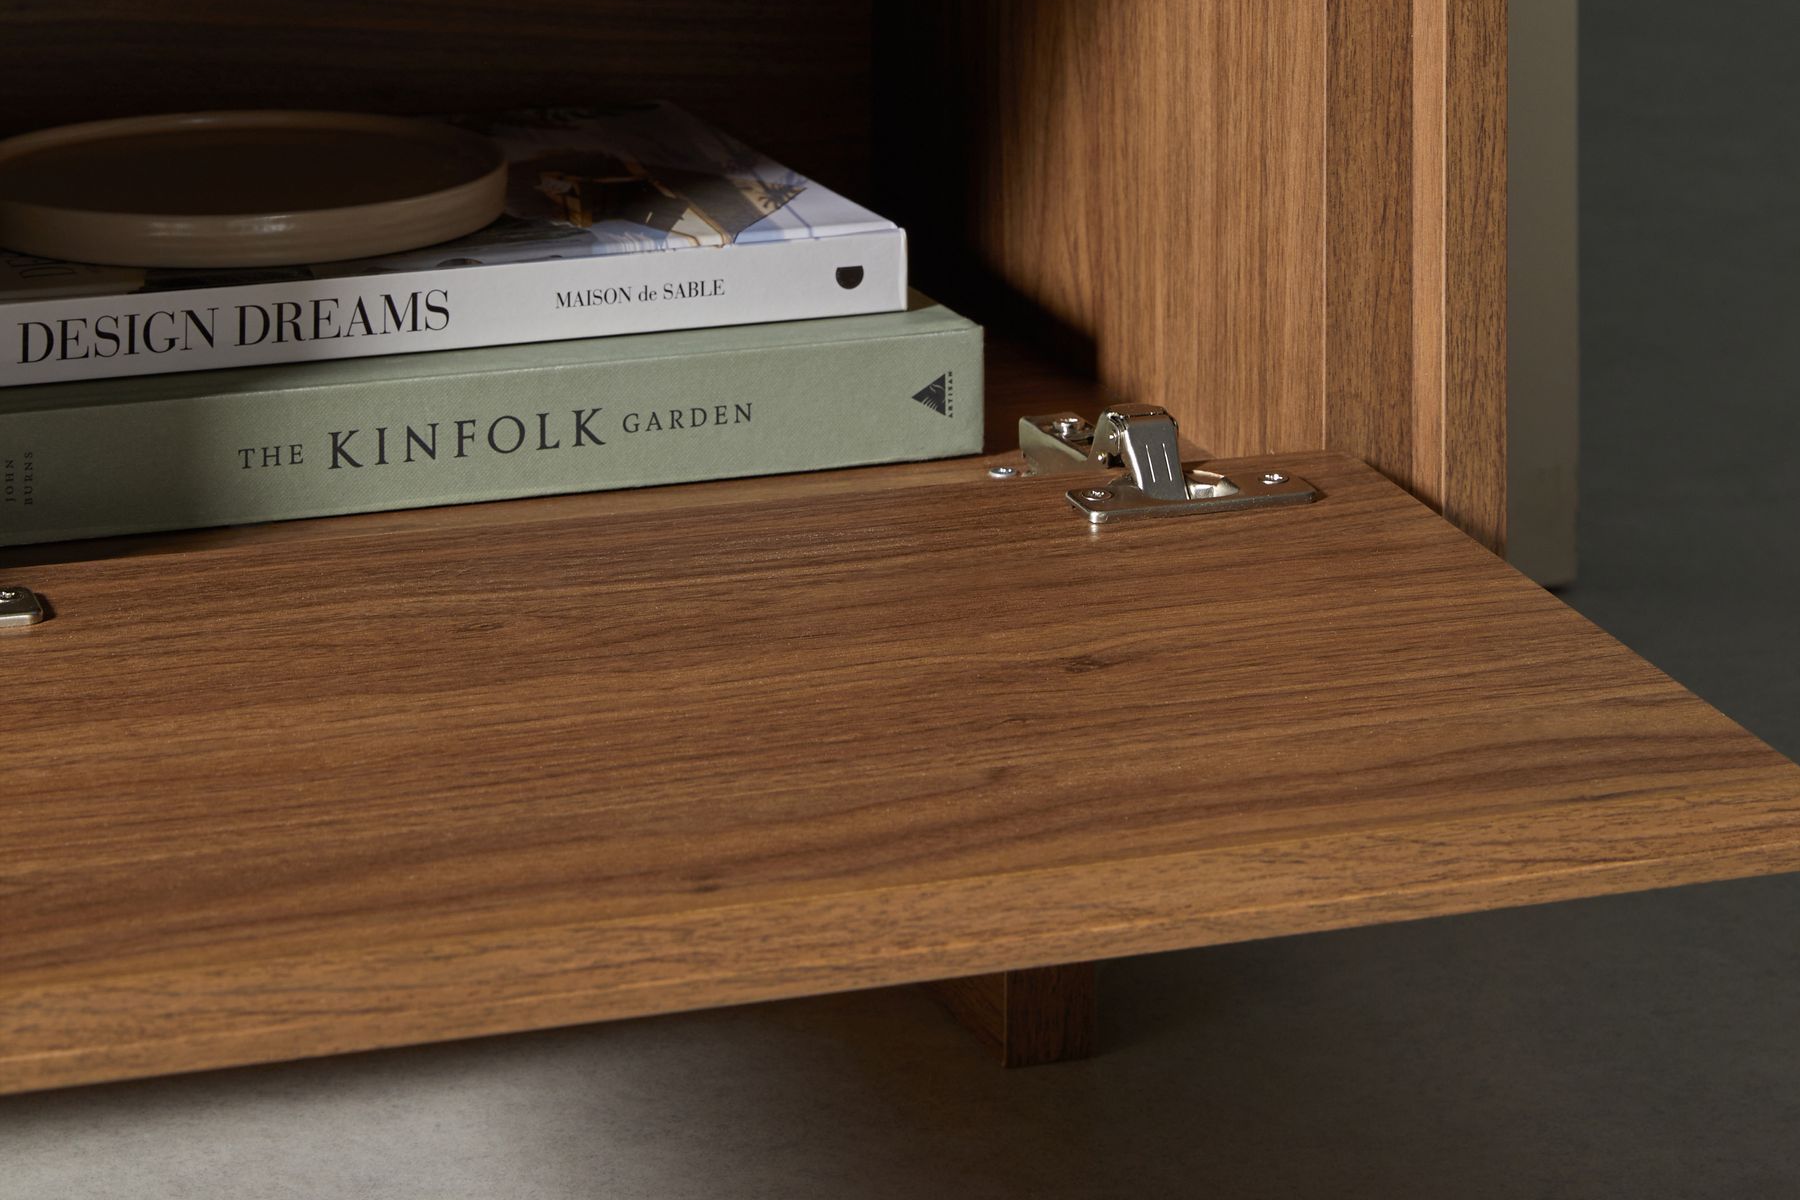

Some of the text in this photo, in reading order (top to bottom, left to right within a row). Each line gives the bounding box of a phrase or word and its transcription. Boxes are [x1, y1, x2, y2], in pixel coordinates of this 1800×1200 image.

[555, 278, 726, 309] MAISON de SABLE
[17, 289, 450, 364] DESIGN DREAMS
[238, 403, 752, 469] THE KINFOLK GARDEN
[5, 459, 16, 502] JOHN
[24, 451, 33, 506] BURNS
